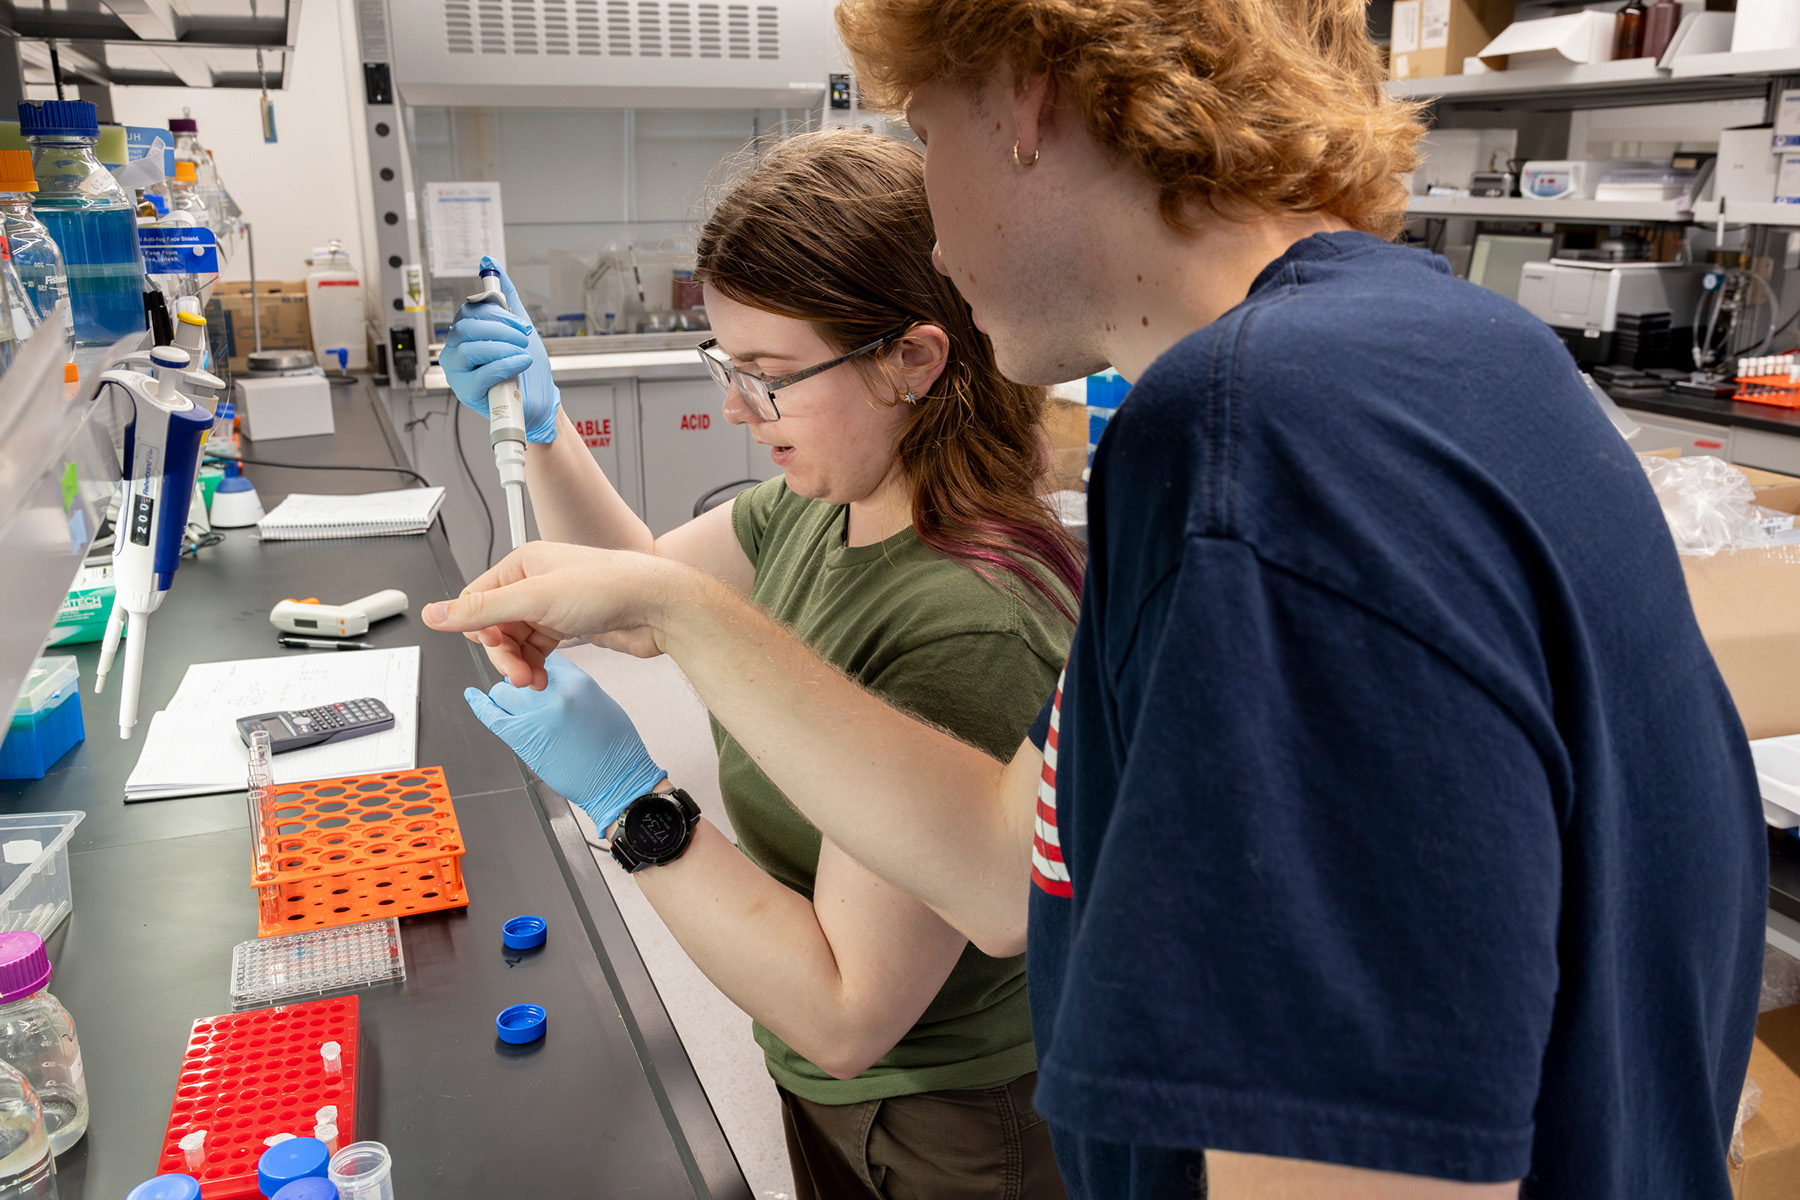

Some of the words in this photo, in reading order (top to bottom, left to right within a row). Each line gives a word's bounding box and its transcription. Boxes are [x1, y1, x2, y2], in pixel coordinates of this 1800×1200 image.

[575, 419, 611, 436] ABLE
[680, 414, 710, 430] ACID
[143, 462, 153, 496] Fisherbrand
[137, 503, 149, 534] 200
[64, 596, 101, 608] MTECH
[642, 813, 669, 844] 17:34
